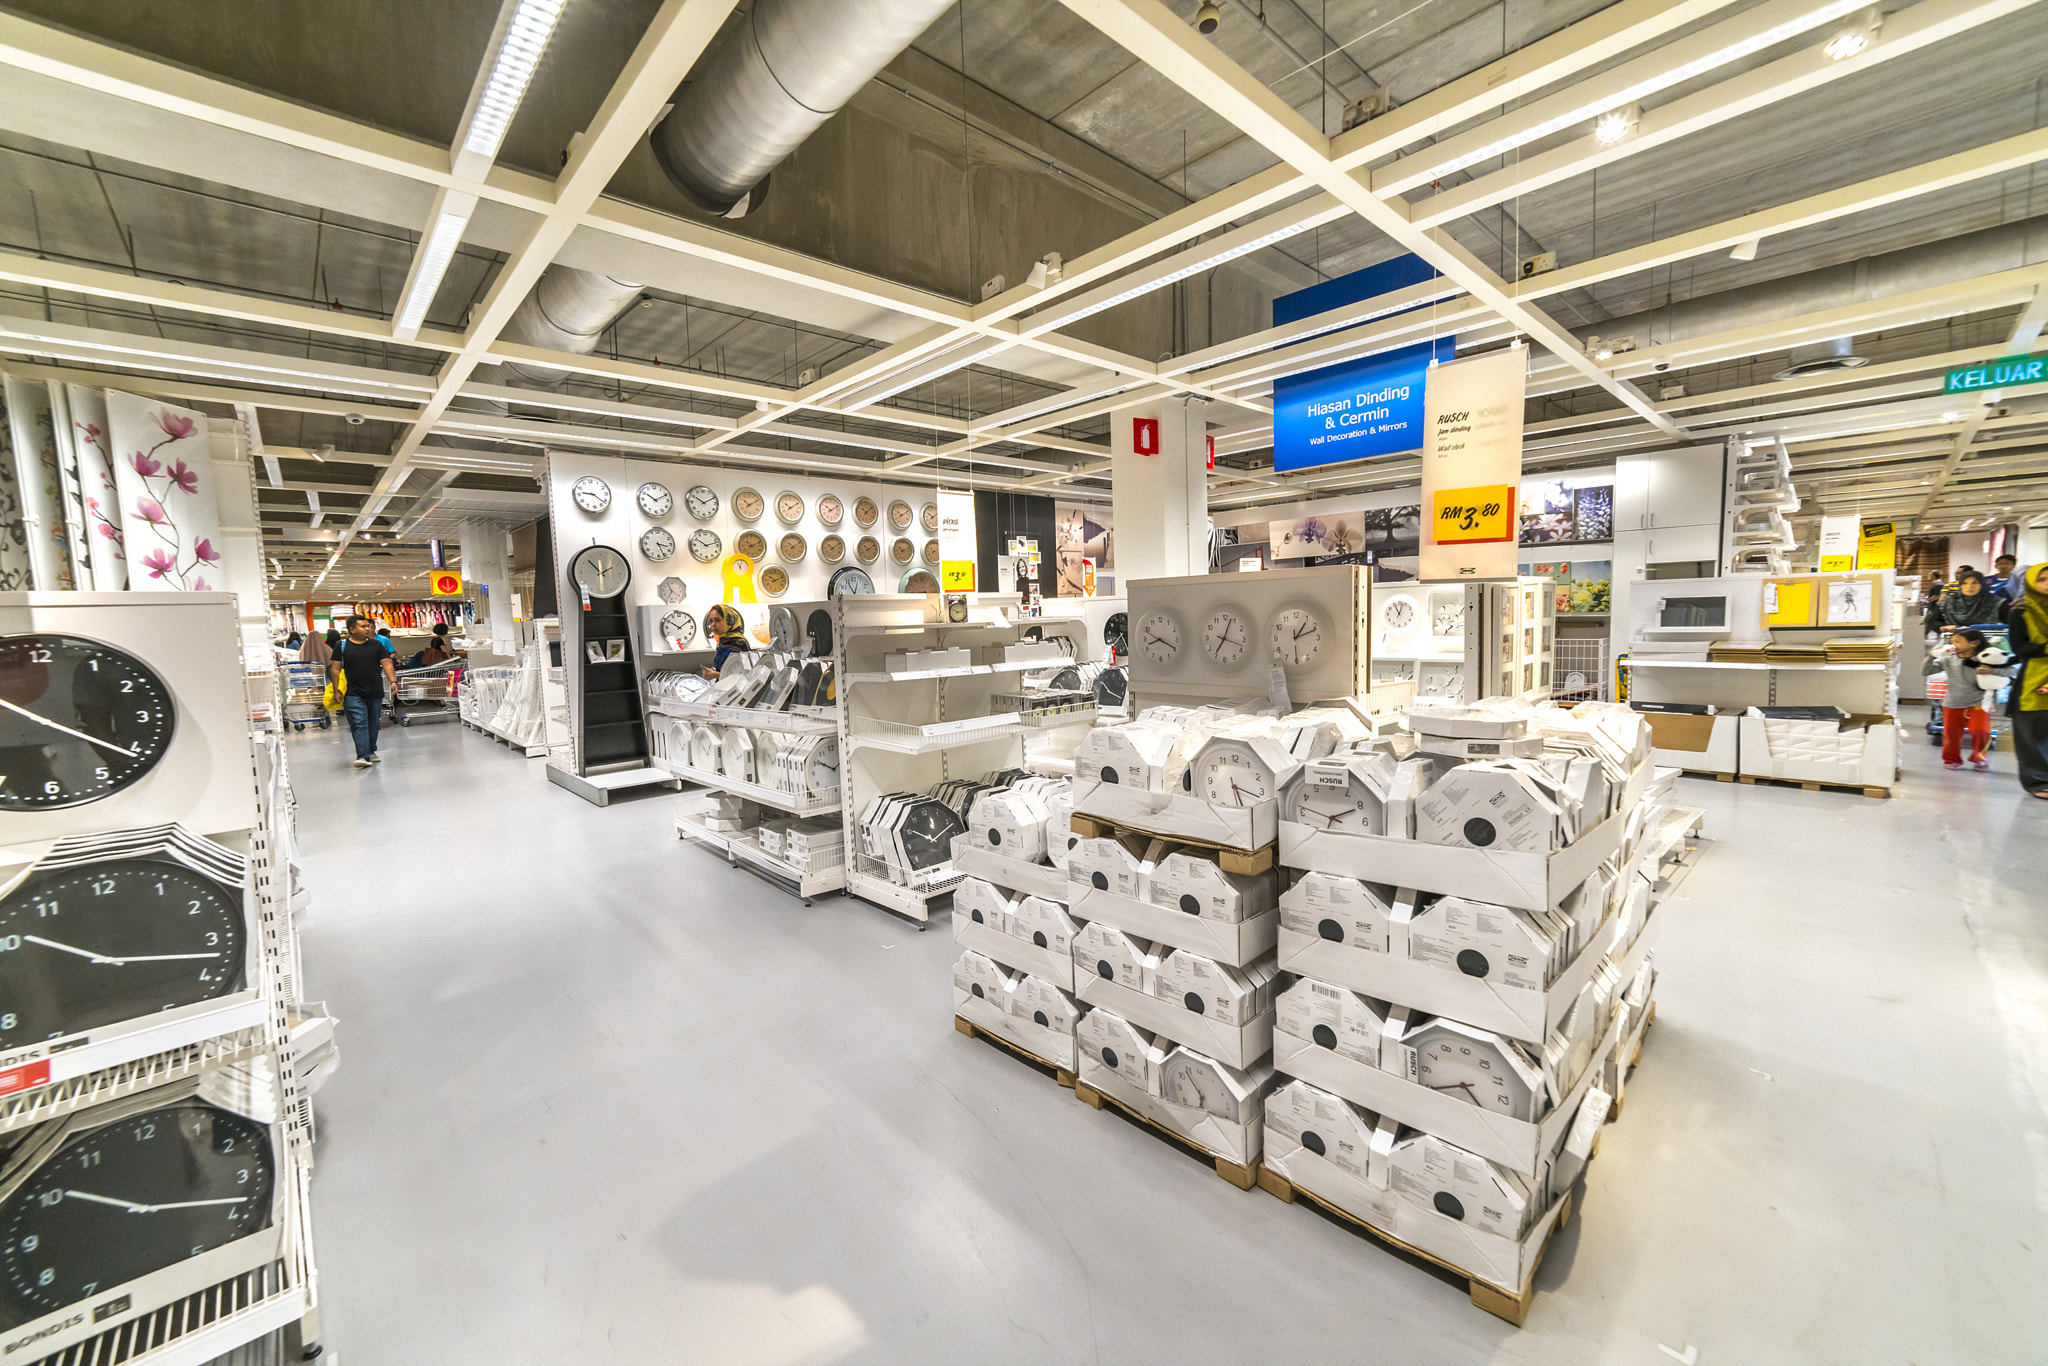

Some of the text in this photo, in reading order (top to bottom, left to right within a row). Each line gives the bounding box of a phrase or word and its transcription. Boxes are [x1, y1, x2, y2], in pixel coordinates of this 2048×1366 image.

[1950, 361, 2044, 390] KELUAR
[1308, 386, 1409, 417] Hiasan Dinding
[1325, 407, 1389, 429] & Cermin
[1437, 411, 1470, 424] RUSCH
[1310, 436, 1324, 445] Wall
[1327, 429, 1367, 443] Decoration
[1379, 422, 1407, 433] Mirrors
[28, 650, 53, 663] 12
[89, 660, 98, 671] 1
[120, 680, 134, 692] 2
[136, 711, 149, 722] 3
[130, 741, 142, 752] 4
[1219, 756, 1226, 765] 11
[1232, 754, 1239, 763] 12
[95, 767, 109, 780] 5
[1210, 764, 1218, 772] 10
[1256, 772, 1261, 781] 2
[1319, 777, 1343, 785] RUSCH
[44, 781, 60, 794] 6
[1260, 788, 1264, 796] 3
[1314, 784, 1319, 793] 5
[1345, 788, 1351, 797] 7
[1303, 793, 1309, 802] 4
[1357, 800, 1364, 810] 8
[92, 880, 116, 896] 12
[155, 882, 164, 896] 1
[36, 901, 59, 917] 11
[188, 900, 201, 915] 2
[205, 932, 218, 946] 3
[198, 968, 212, 981] 4
[0, 1013, 18, 1030] 8
[1440, 1044, 1451, 1053] 8
[1460, 1047, 1471, 1055] 9
[1427, 1053, 1438, 1061] 7
[1479, 1059, 1491, 1070] 10
[1492, 1076, 1504, 1086] 11
[1498, 1094, 1509, 1106] 12
[133, 1124, 156, 1141] 12
[193, 1123, 200, 1136] 1
[222, 1138, 235, 1154] 2
[80, 1150, 100, 1169] 11
[237, 1169, 249, 1184] 3
[38, 1188, 63, 1209] 10
[228, 1206, 238, 1220] 4
[20, 1234, 39, 1252] 9
[38, 1268, 55, 1286] 8
[3, 1313, 84, 1355] BONDIS
